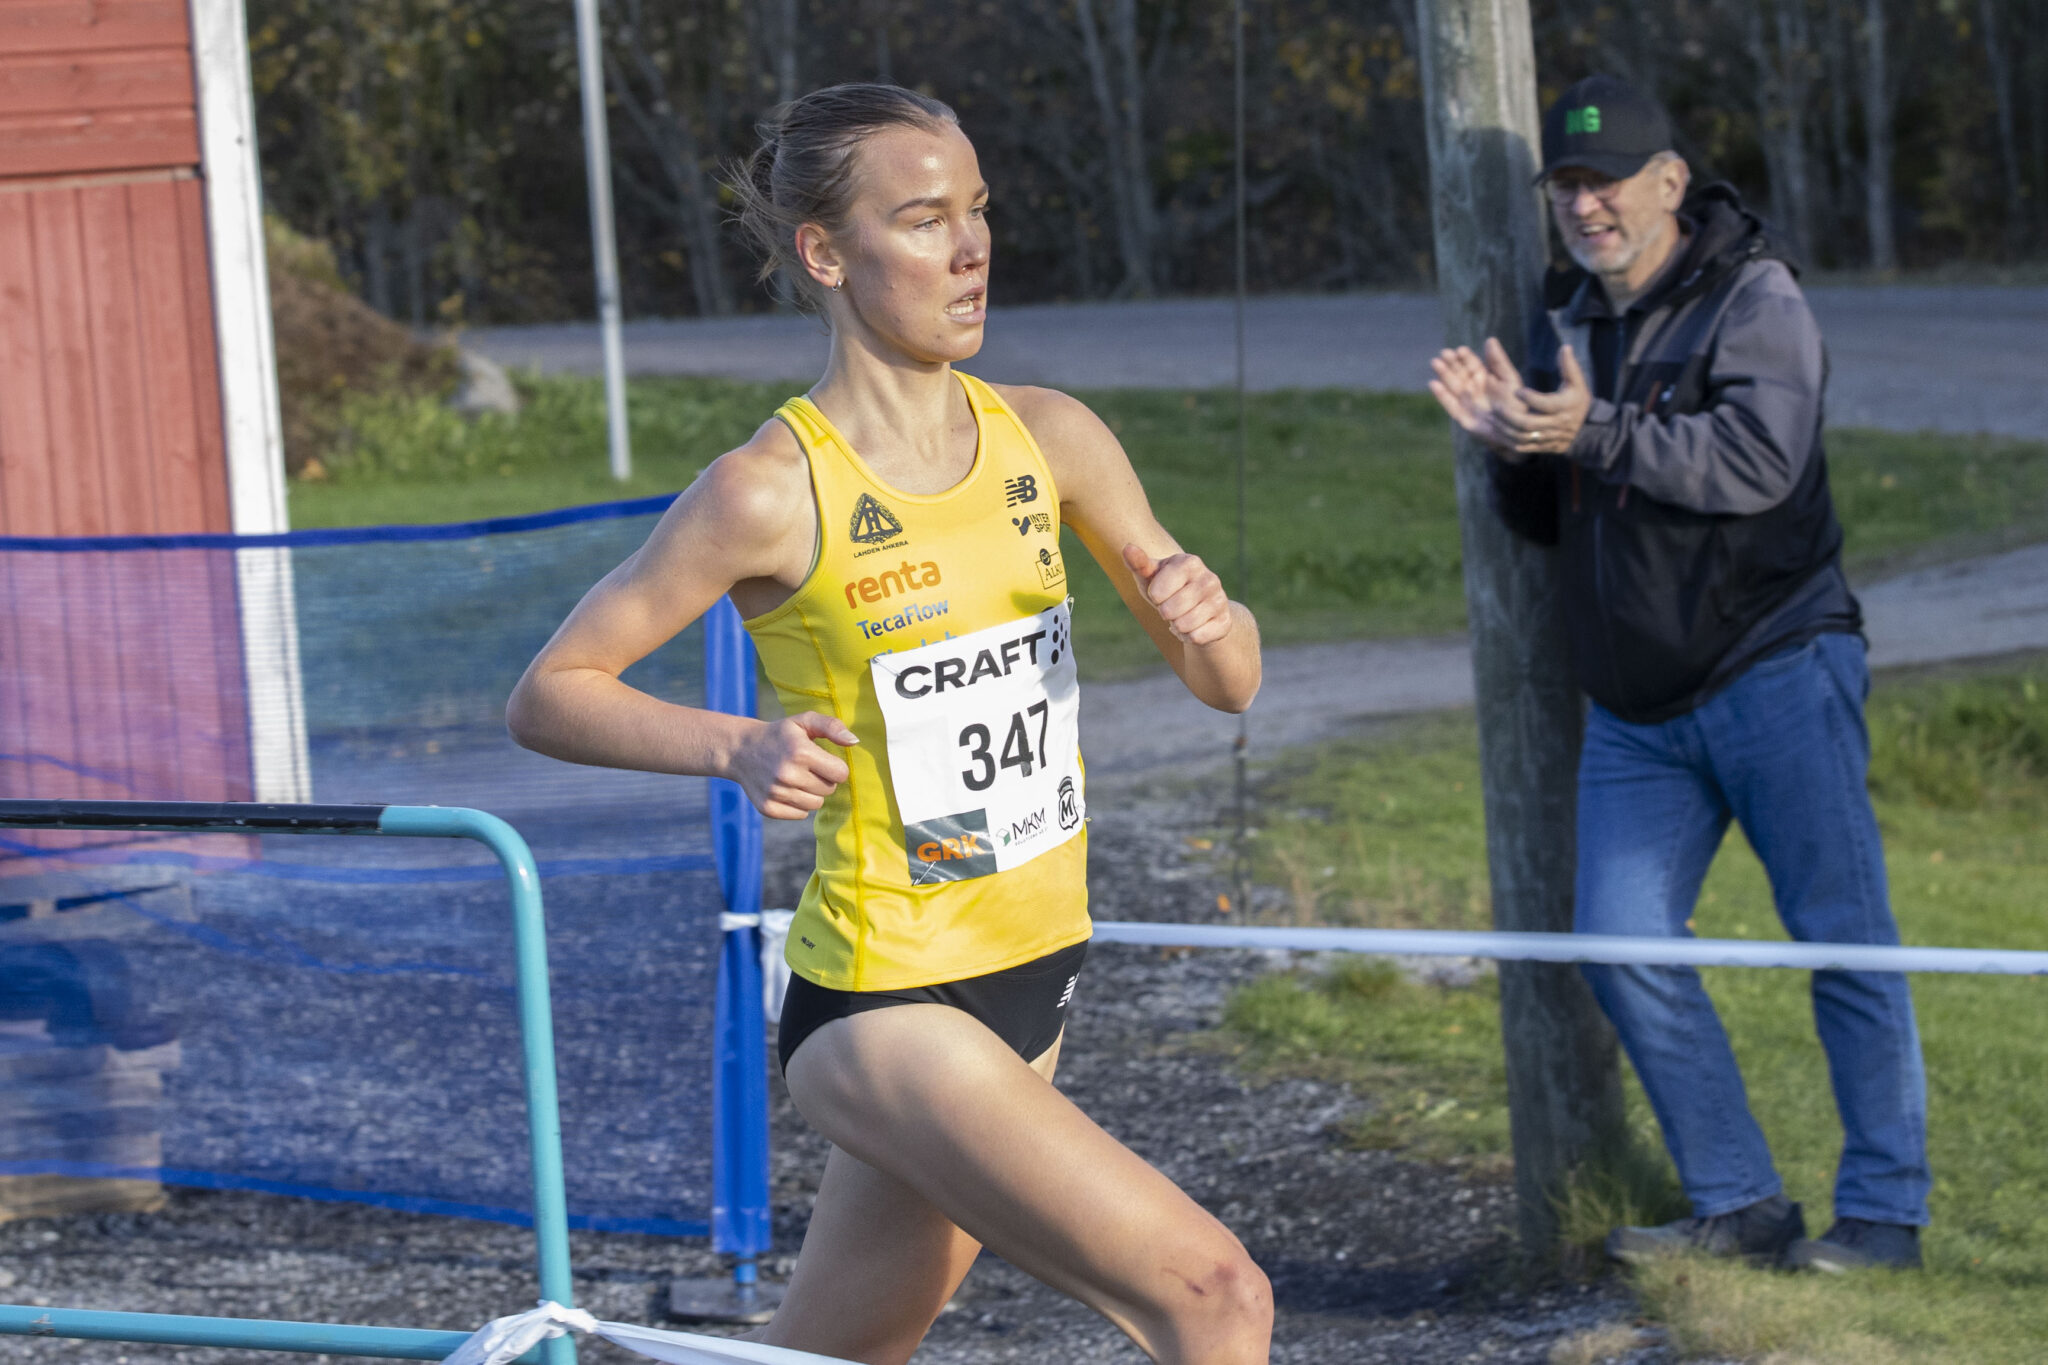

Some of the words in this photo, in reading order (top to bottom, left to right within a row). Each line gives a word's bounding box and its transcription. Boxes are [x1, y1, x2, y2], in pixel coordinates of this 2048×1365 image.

[853, 547, 881, 558] LAHDEN
[882, 540, 909, 551] AHKERA
[844, 560, 942, 610] renta
[857, 600, 949, 639] TecaFlow
[895, 629, 1047, 699] CRAFT
[958, 698, 1048, 791] 347
[1012, 807, 1047, 840] MKM
[917, 835, 985, 863] GRK
